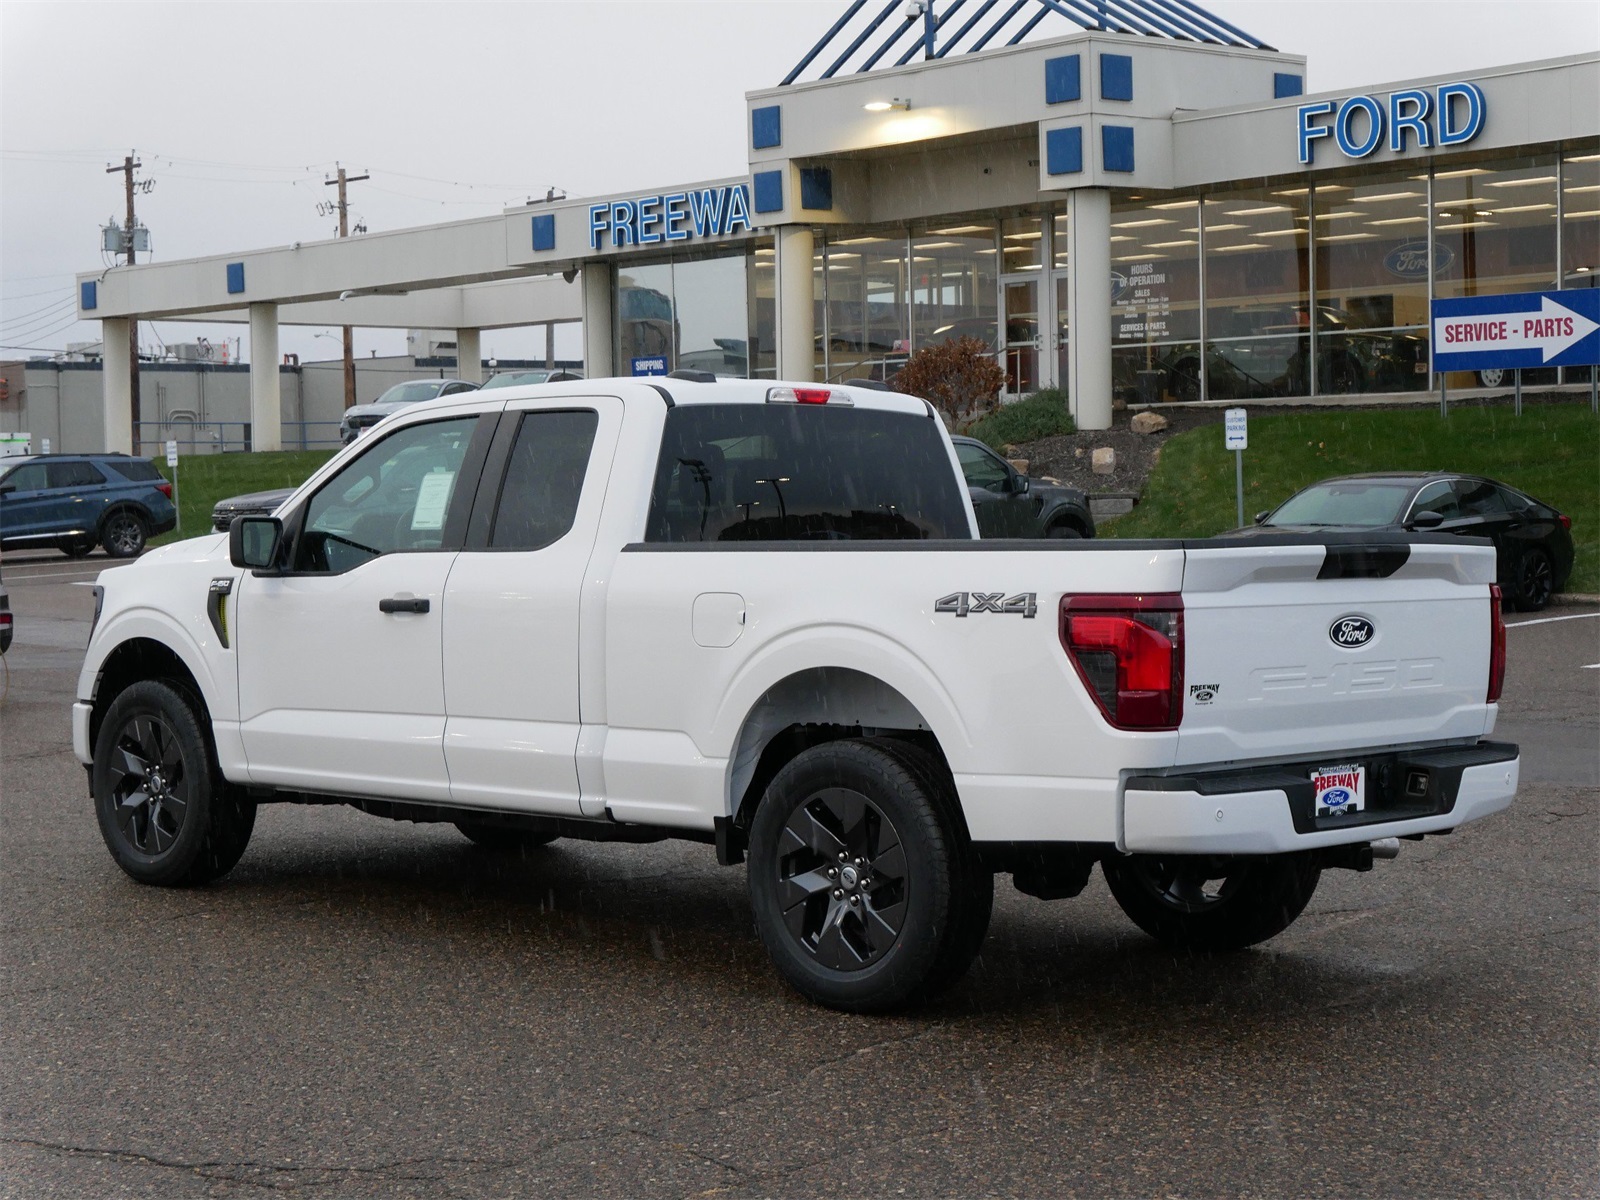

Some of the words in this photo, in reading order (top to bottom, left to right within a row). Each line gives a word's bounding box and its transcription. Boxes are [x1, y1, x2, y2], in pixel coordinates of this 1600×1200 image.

[1297, 82, 1487, 164] FORD
[588, 184, 755, 250] FREEWA
[1131, 264, 1153, 275] HOURS
[1120, 277, 1128, 287] OF
[1130, 273, 1165, 287] OPERATION
[1134, 289, 1150, 297] SALES
[1120, 323, 1144, 332] SERVICES
[1149, 321, 1166, 330] PARTS
[1445, 321, 1507, 343] SERVICE
[1524, 317, 1573, 338] PARTS
[635, 359, 664, 371] SHIPPING
[1338, 620, 1367, 642] Ford
[1248, 656, 1444, 701] F-150
[1190, 684, 1220, 696] FREEWAY
[1313, 772, 1360, 798] FREEWAY
[1327, 791, 1345, 804] Ford
